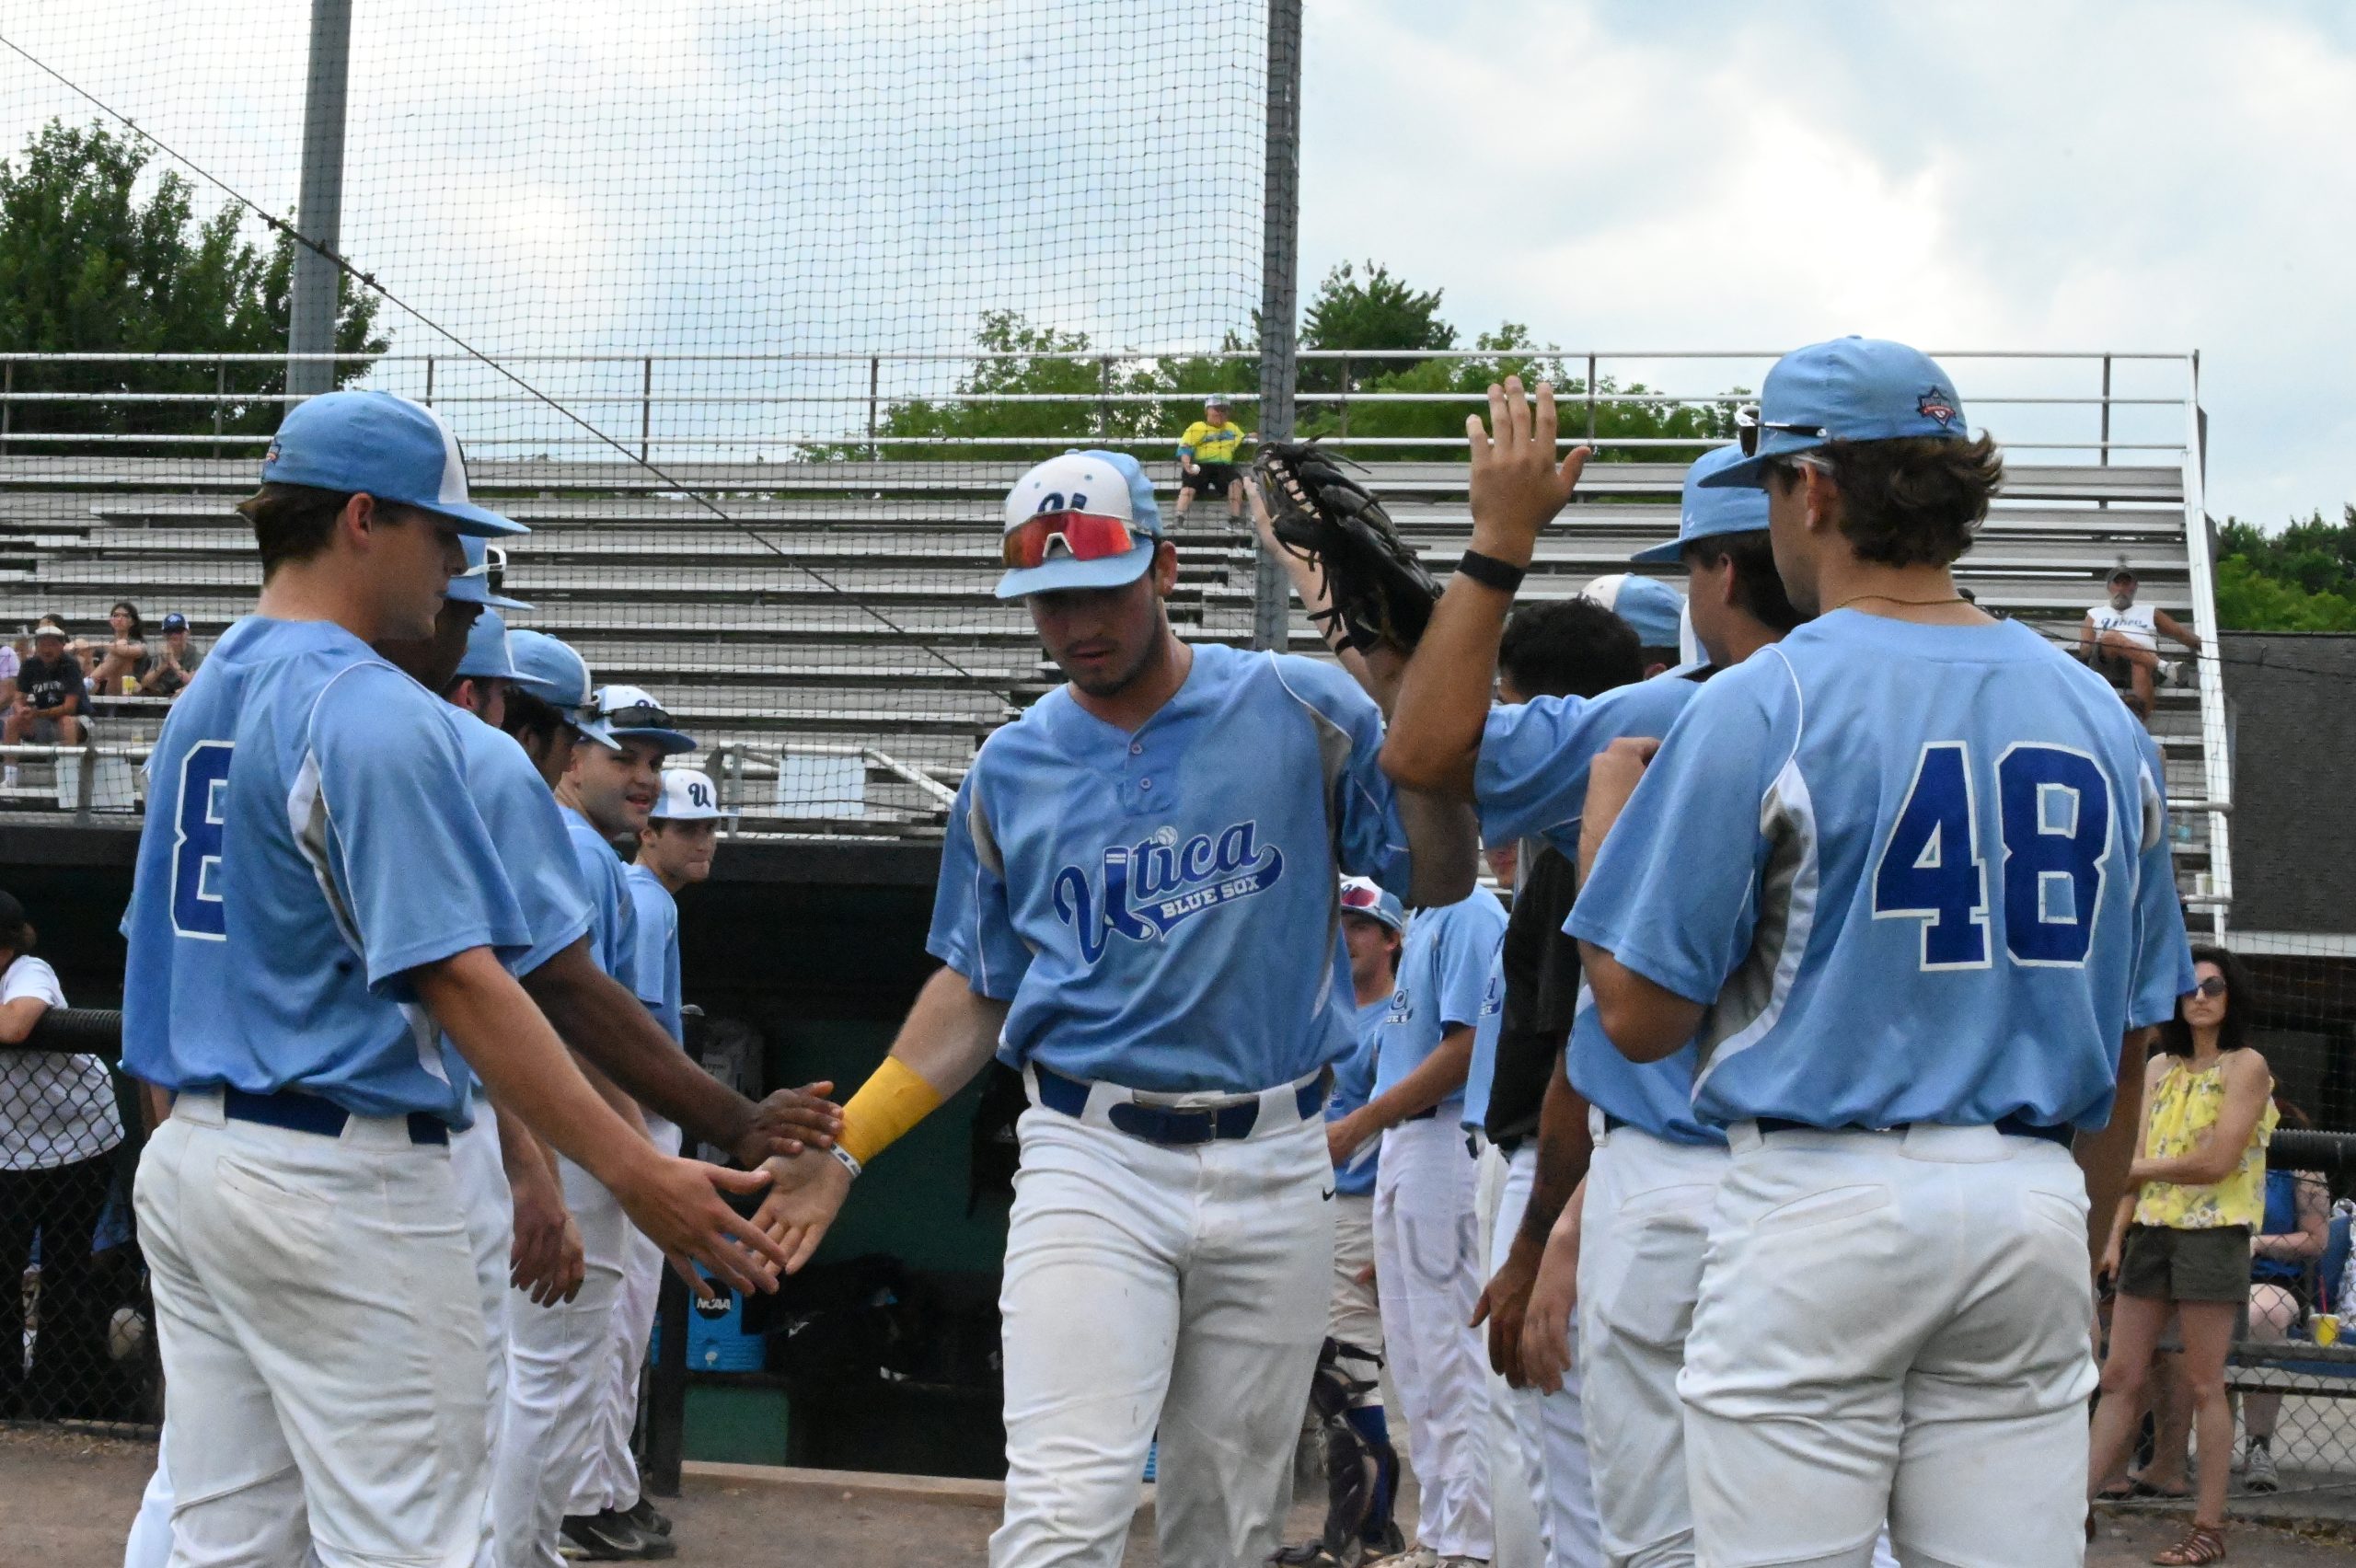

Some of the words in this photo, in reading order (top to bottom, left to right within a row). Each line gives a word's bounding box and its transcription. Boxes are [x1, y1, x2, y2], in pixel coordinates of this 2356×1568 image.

[687, 782, 712, 808] U
[1872, 740, 2114, 972] 48
[1053, 820, 1268, 964] Utica
[1160, 887, 1218, 920] BLUE
[1221, 875, 1261, 900] SOX
[697, 1297, 731, 1310] NCAA
